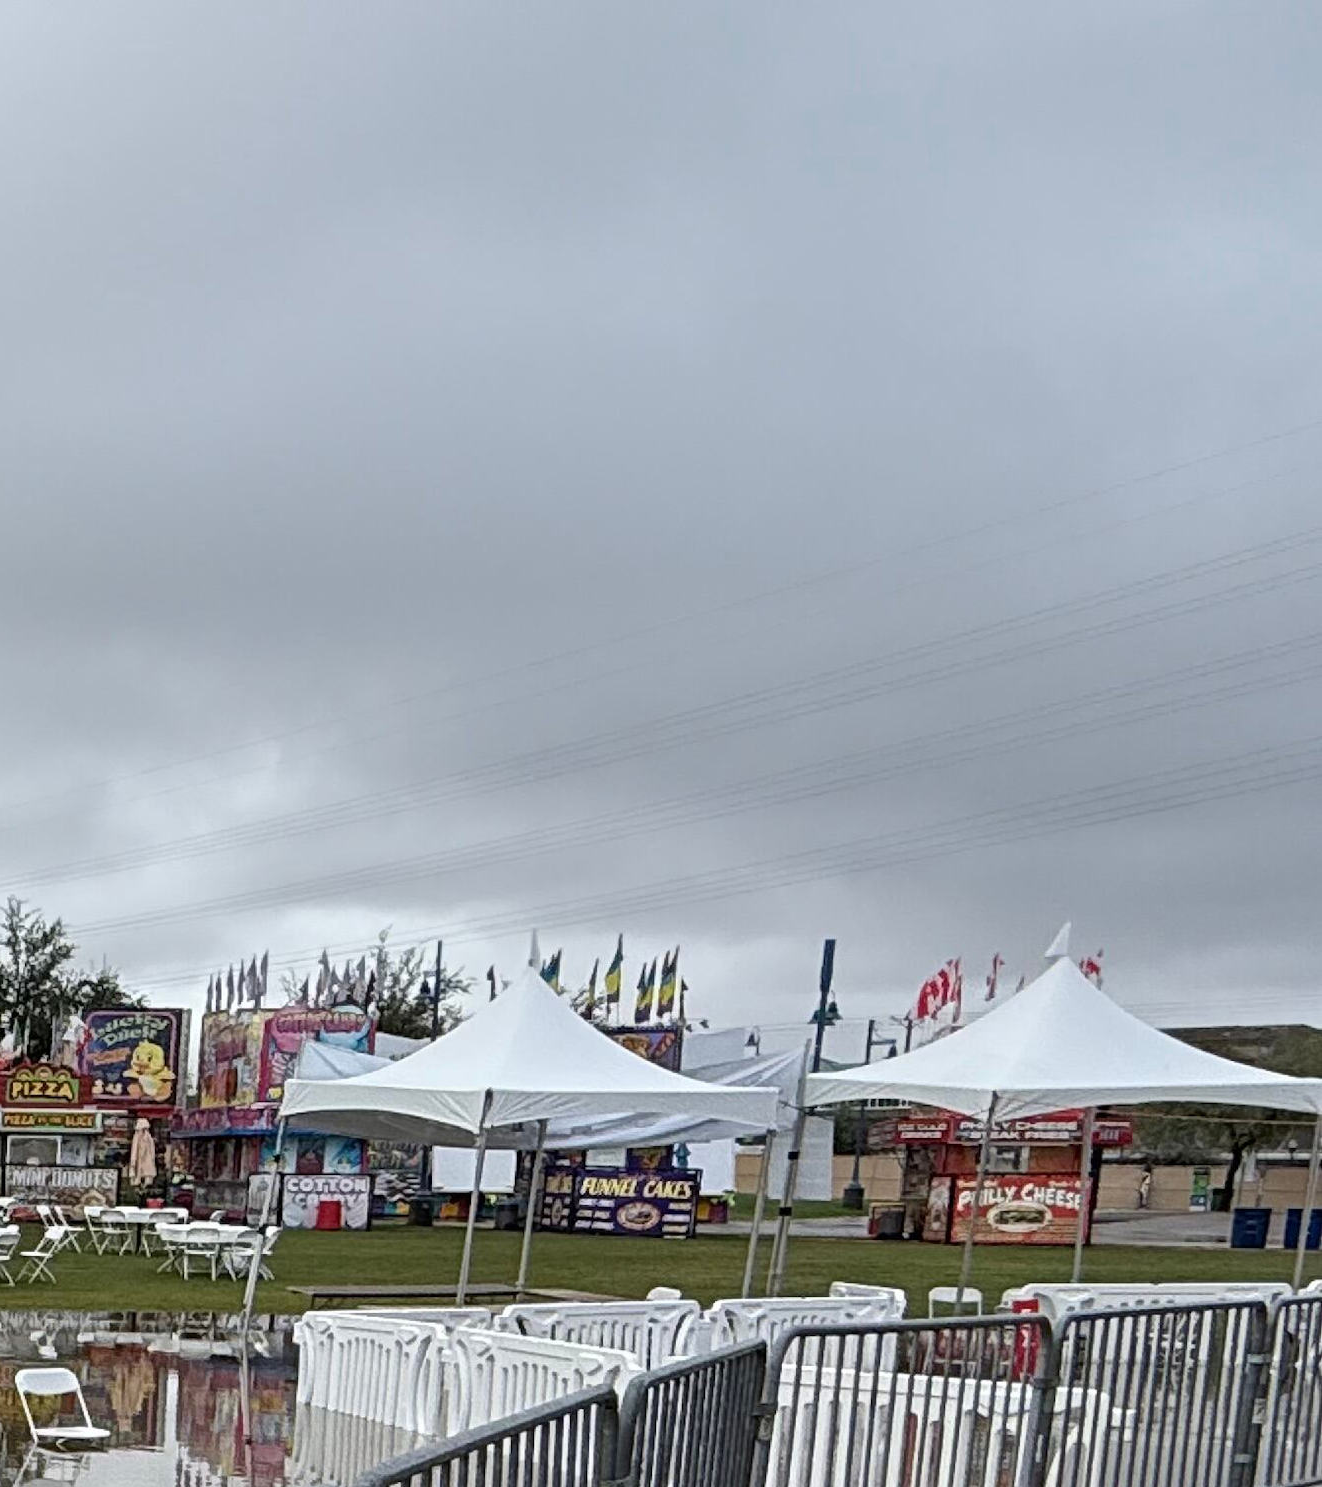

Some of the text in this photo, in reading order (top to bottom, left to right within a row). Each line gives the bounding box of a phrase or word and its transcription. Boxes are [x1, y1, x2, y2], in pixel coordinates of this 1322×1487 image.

[11, 1081, 74, 1100] PIZZA
[51, 1167, 117, 1187] DONUTS
[287, 1178, 367, 1193] COTTON
[580, 1177, 639, 1198] FUNNEL
[643, 1181, 693, 1200] CAKES
